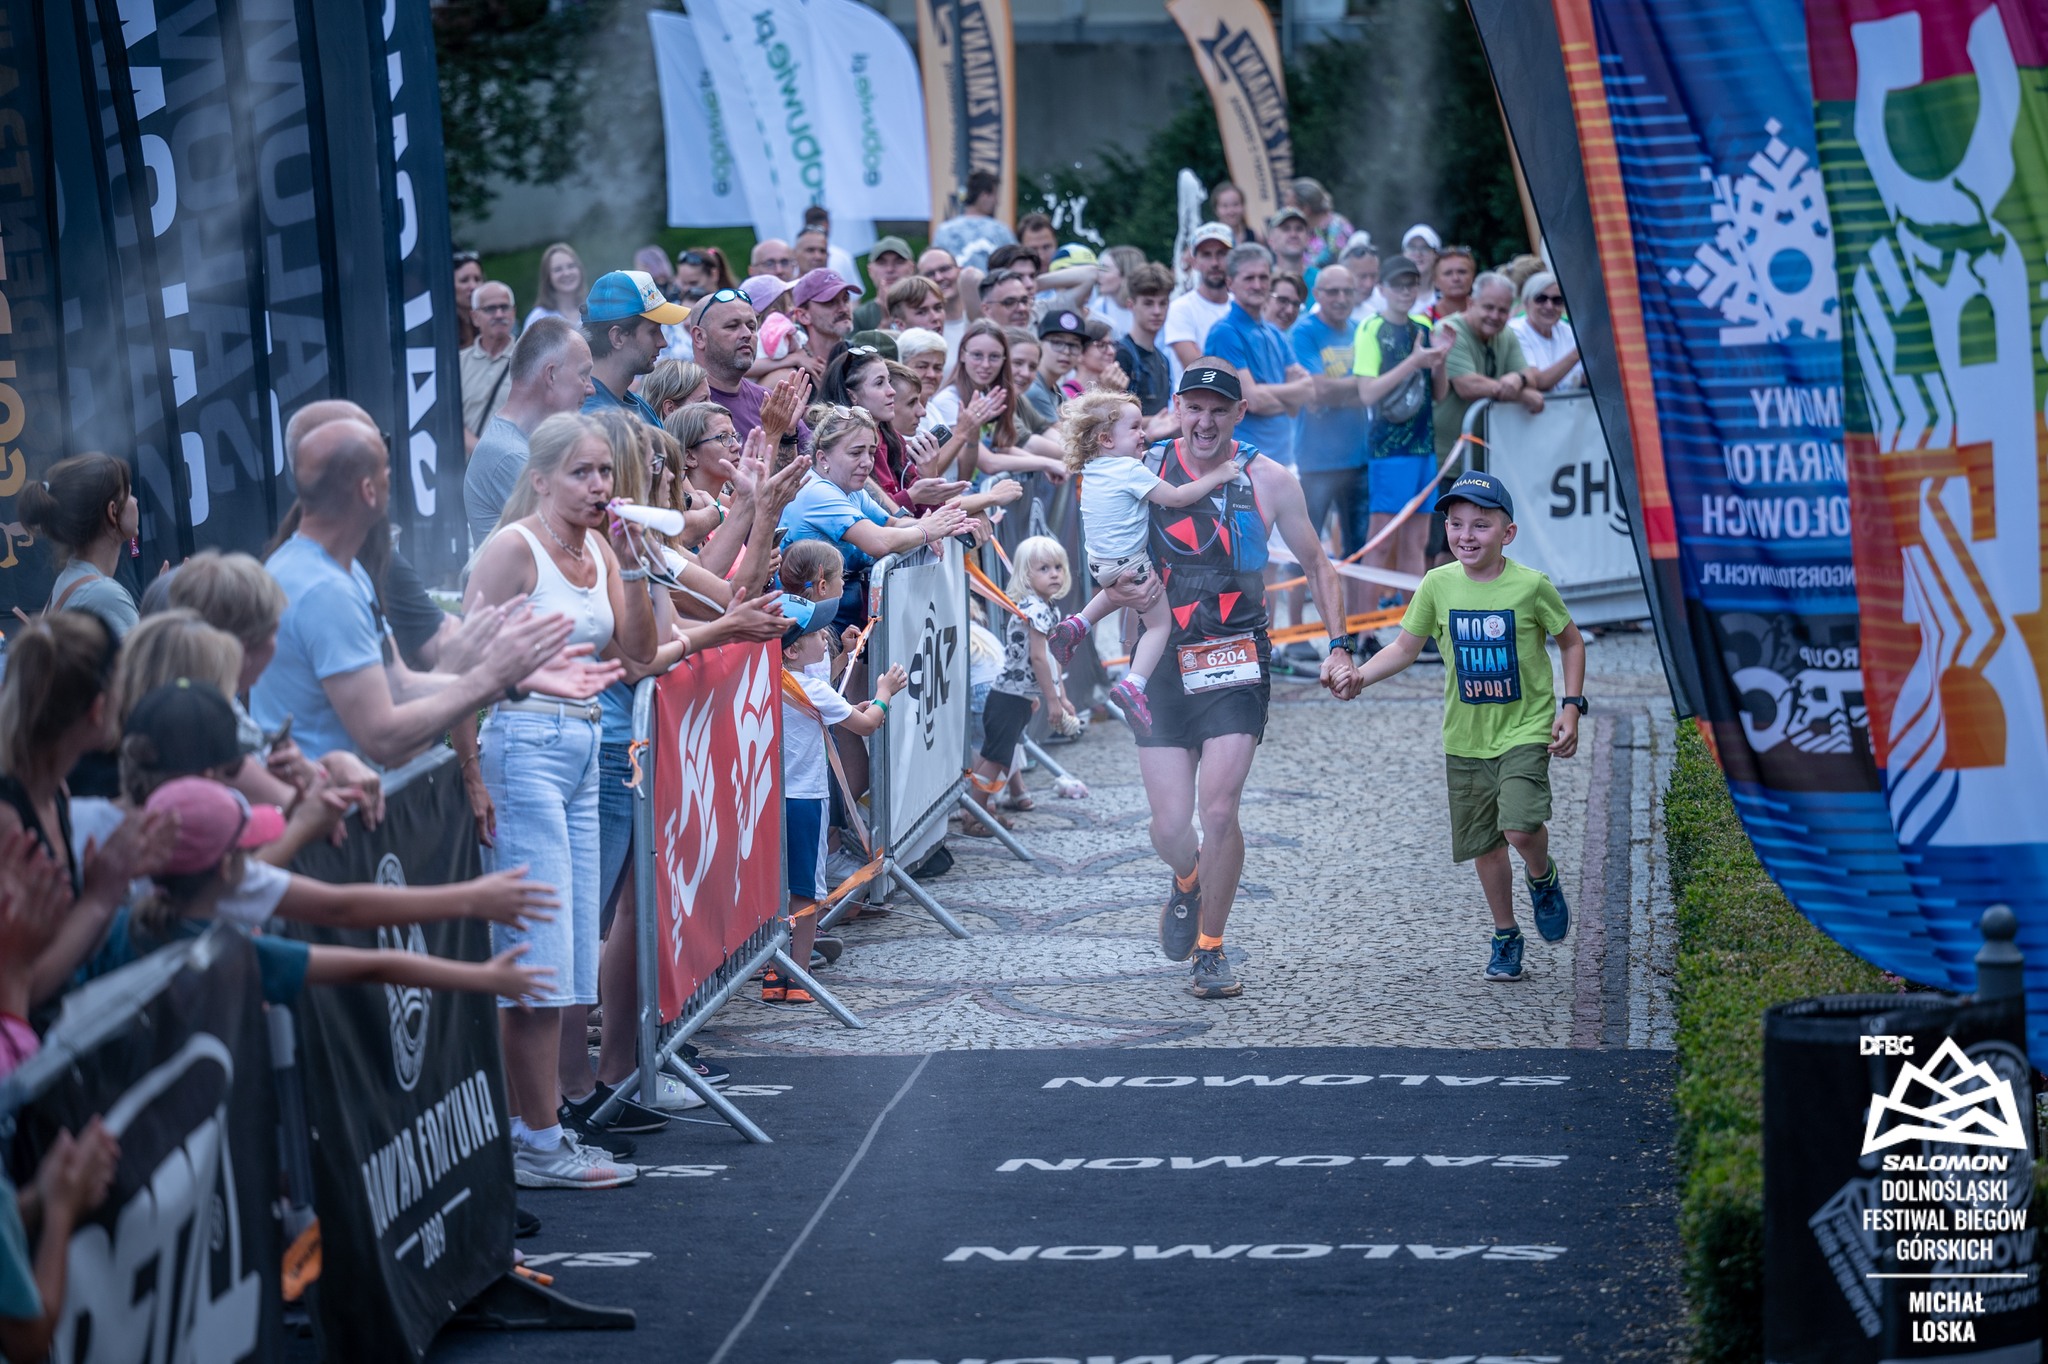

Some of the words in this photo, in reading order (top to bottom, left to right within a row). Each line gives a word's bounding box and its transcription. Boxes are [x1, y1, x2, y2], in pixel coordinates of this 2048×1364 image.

[1457, 617, 1505, 641] MO
[1206, 648, 1248, 667] 6204
[1459, 646, 1509, 672] THAN
[1464, 677, 1512, 698] SPORT
[664, 807, 683, 967] HIGH
[1041, 1074, 1572, 1089] SALOMON
[416, 1069, 500, 1190] FORTUNA
[995, 1154, 1571, 1173] SALOMON
[943, 1244, 1569, 1262] SALOMON
